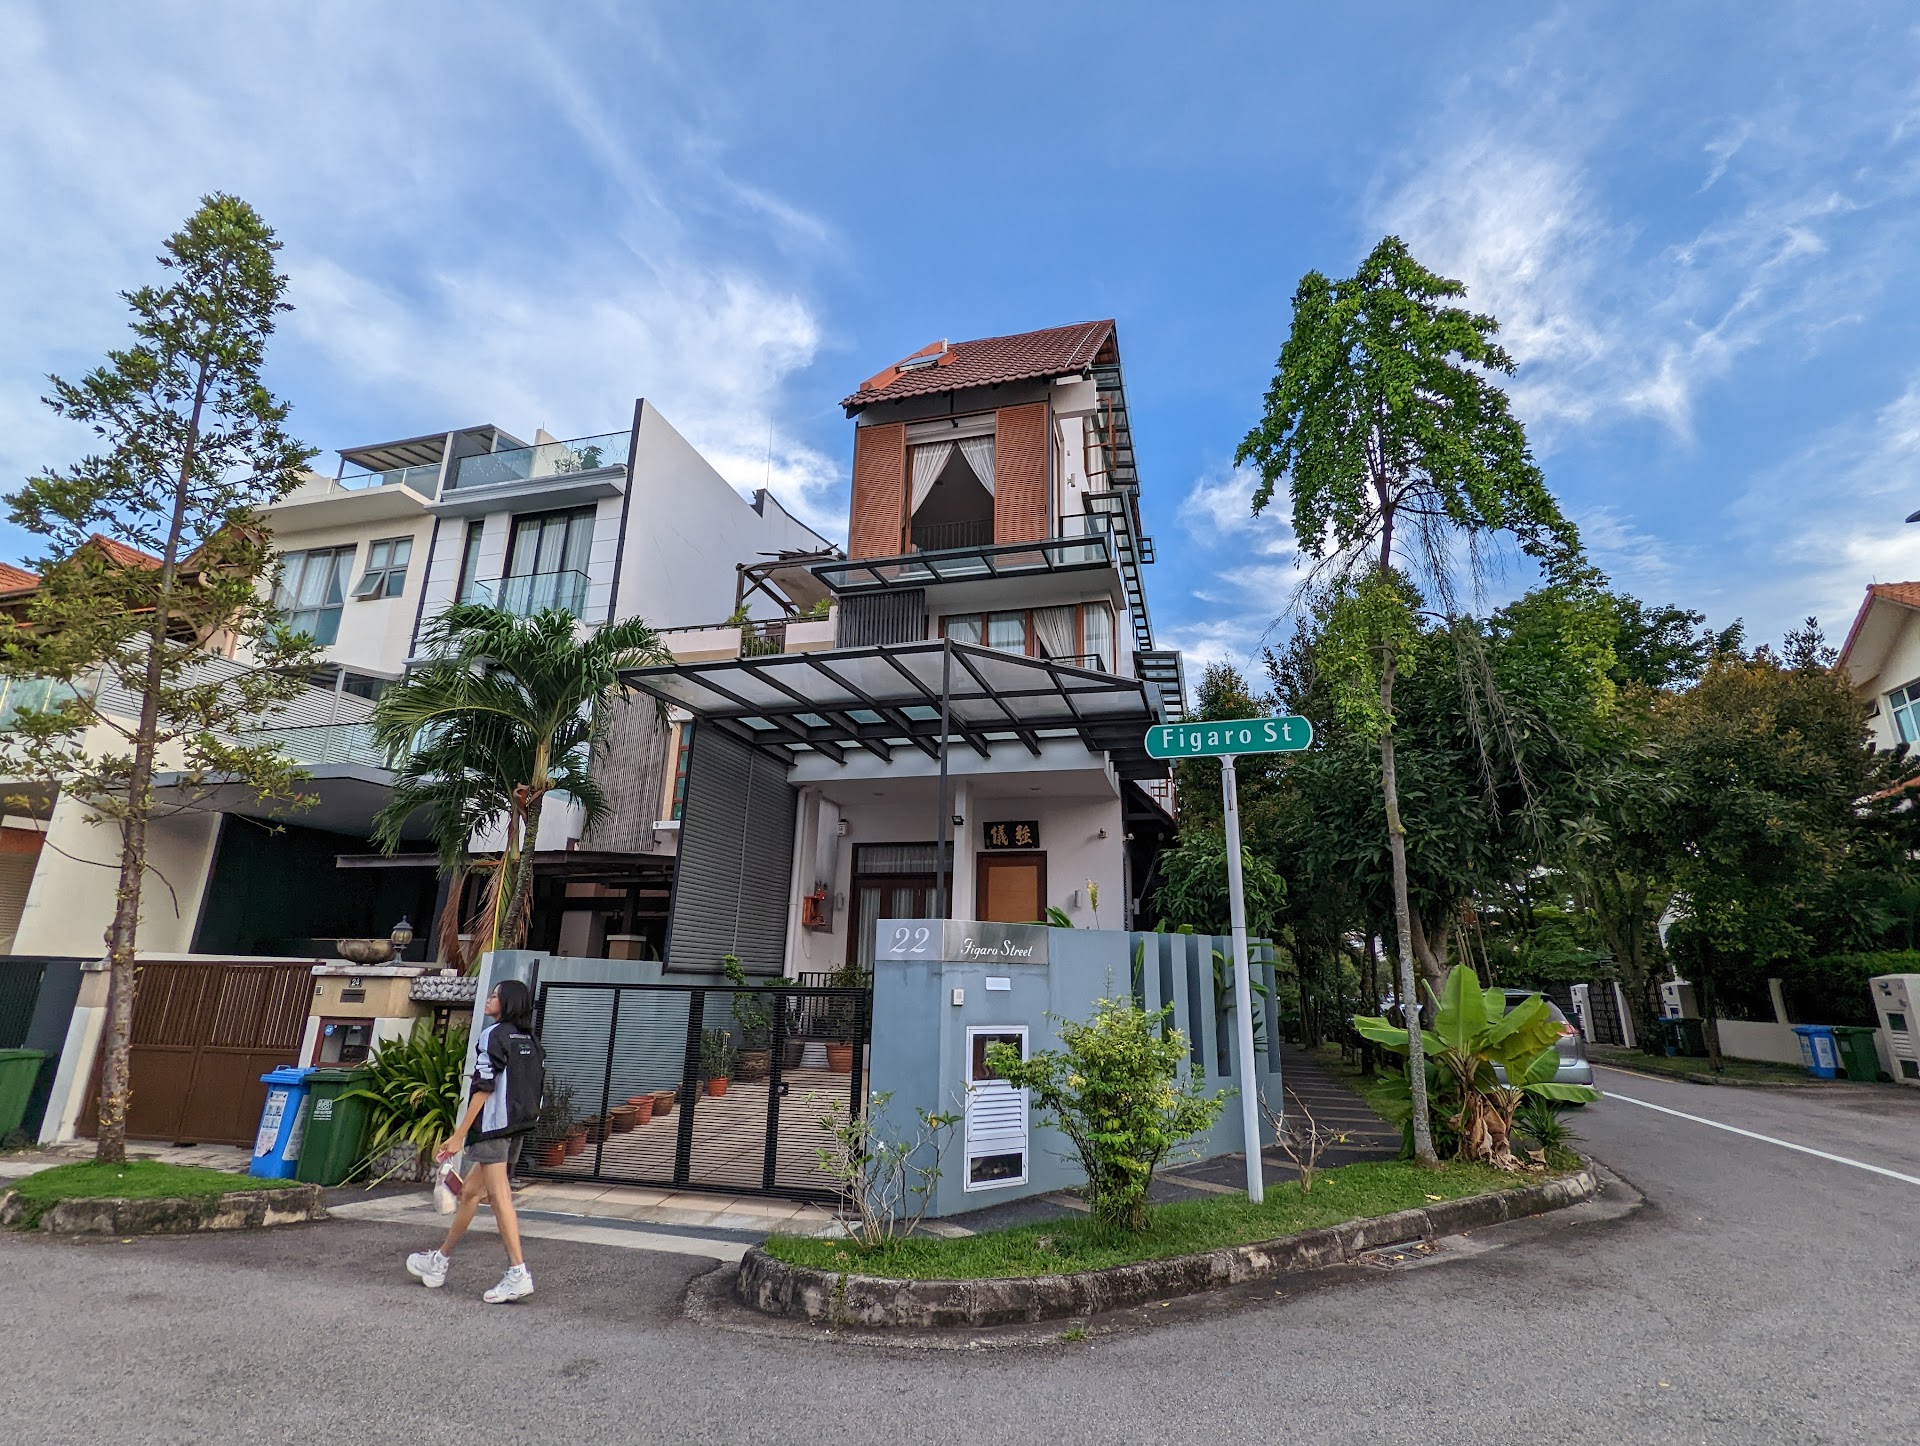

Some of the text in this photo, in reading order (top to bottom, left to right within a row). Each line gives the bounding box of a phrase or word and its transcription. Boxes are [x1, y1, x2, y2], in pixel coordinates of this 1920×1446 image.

[1162, 722, 1293, 752] Figaro St
[889, 927, 930, 953] 22
[960, 938, 1033, 959] Figaro Street
